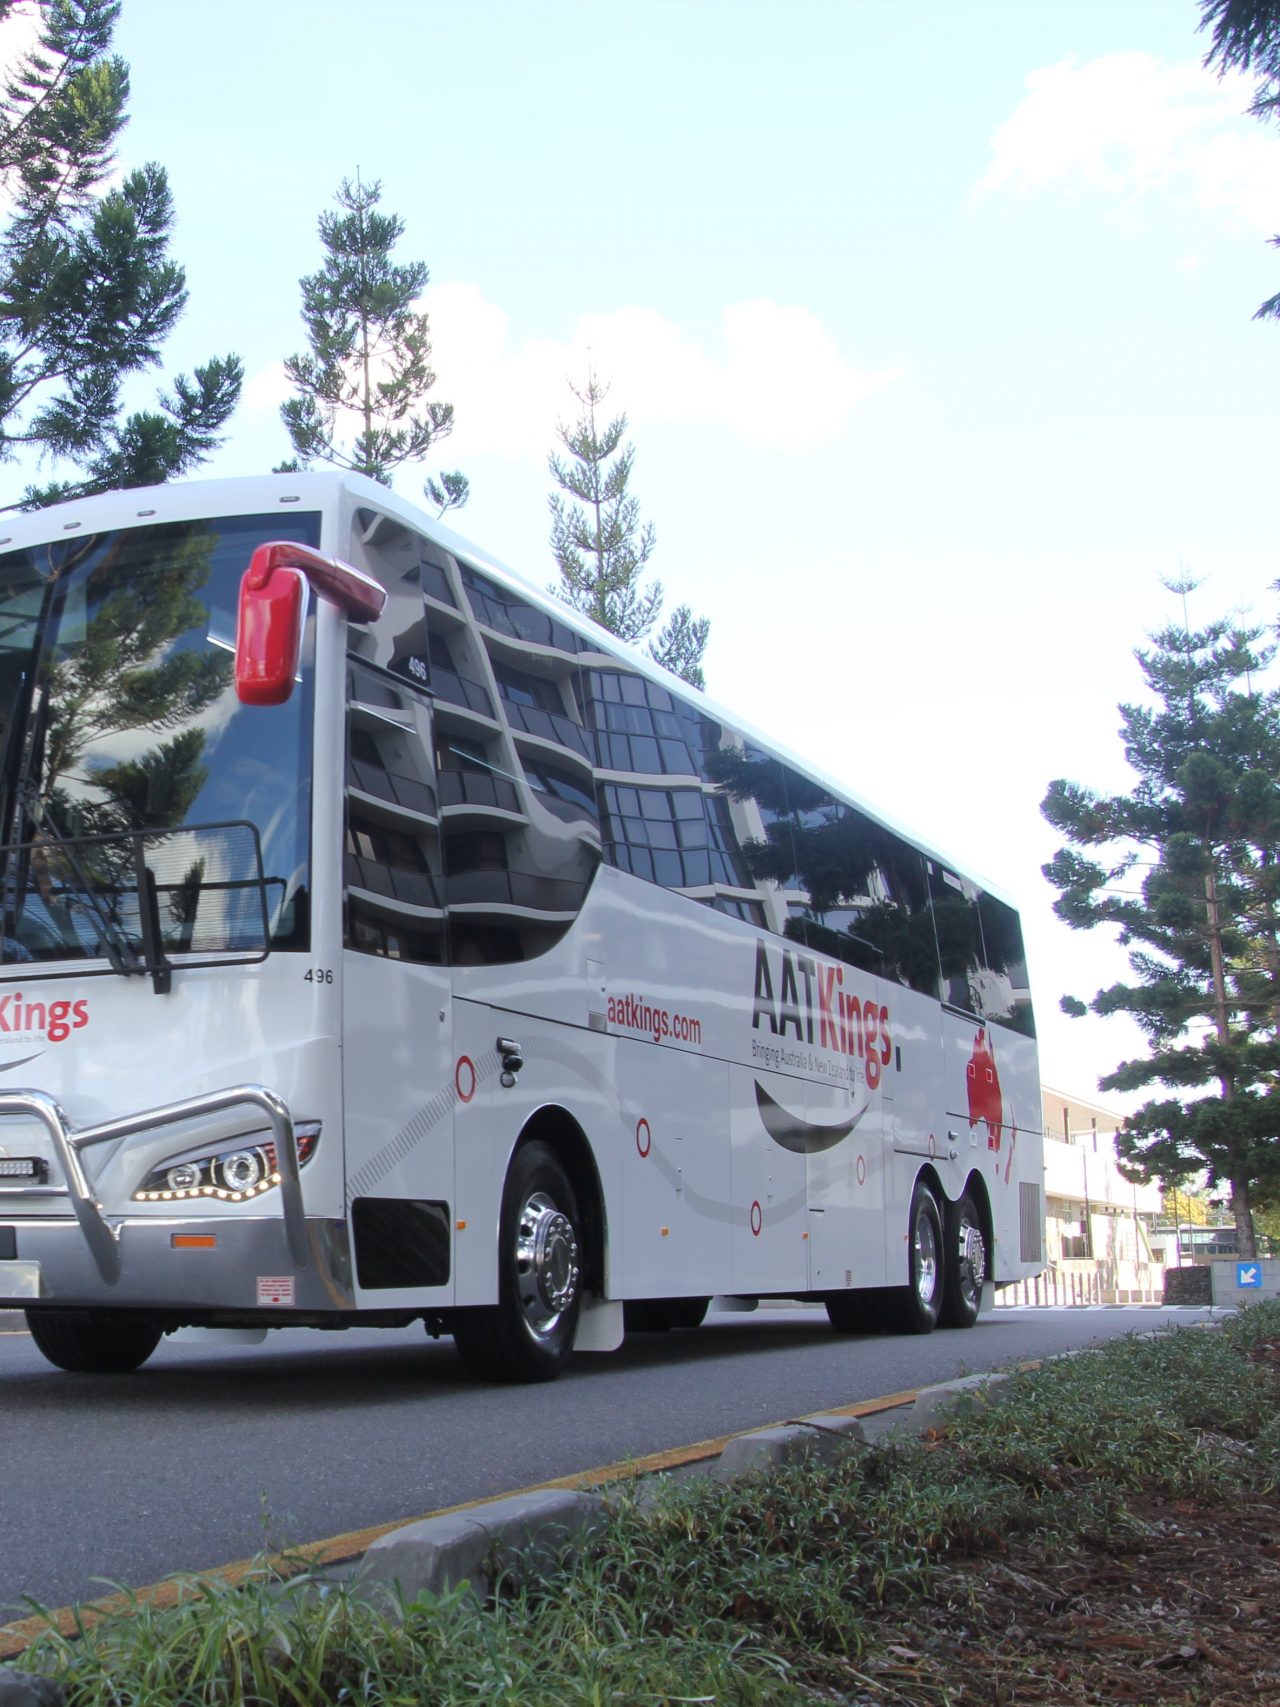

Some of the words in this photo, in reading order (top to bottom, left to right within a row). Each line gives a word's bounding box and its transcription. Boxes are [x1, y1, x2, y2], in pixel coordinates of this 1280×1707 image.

[408, 656, 427, 681] 496
[303, 968, 333, 985] 496
[607, 992, 702, 1045] aatkings.com
[752, 938, 892, 1091] AATKings
[751, 1038, 780, 1069] Bringing
[780, 1047, 808, 1070] Australia
[814, 1055, 828, 1075] New
